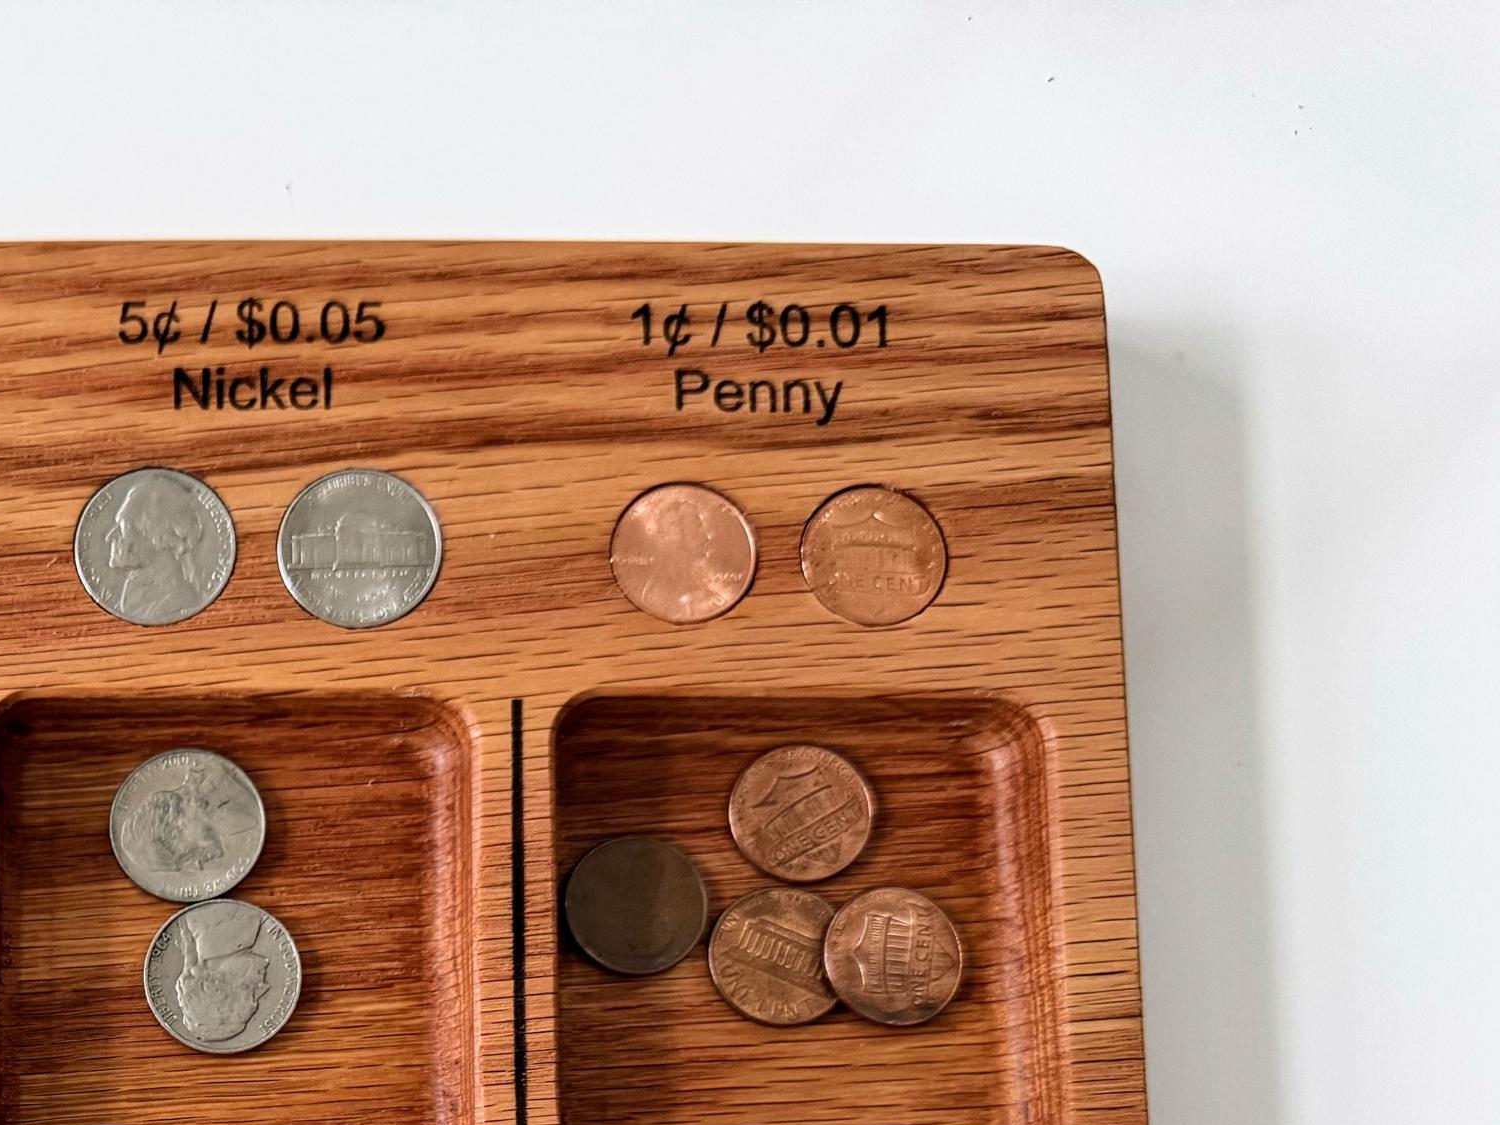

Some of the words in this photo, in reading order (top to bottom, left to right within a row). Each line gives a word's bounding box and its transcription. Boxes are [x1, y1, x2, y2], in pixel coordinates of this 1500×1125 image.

[118, 300, 182, 356] 5¢
[200, 299, 218, 344] /
[235, 297, 387, 350] $0.05
[631, 303, 693, 357] 1¢
[710, 301, 728, 348] /
[746, 300, 889, 353] $0.01
[173, 366, 334, 411] Nickel
[674, 368, 844, 428] Penny
